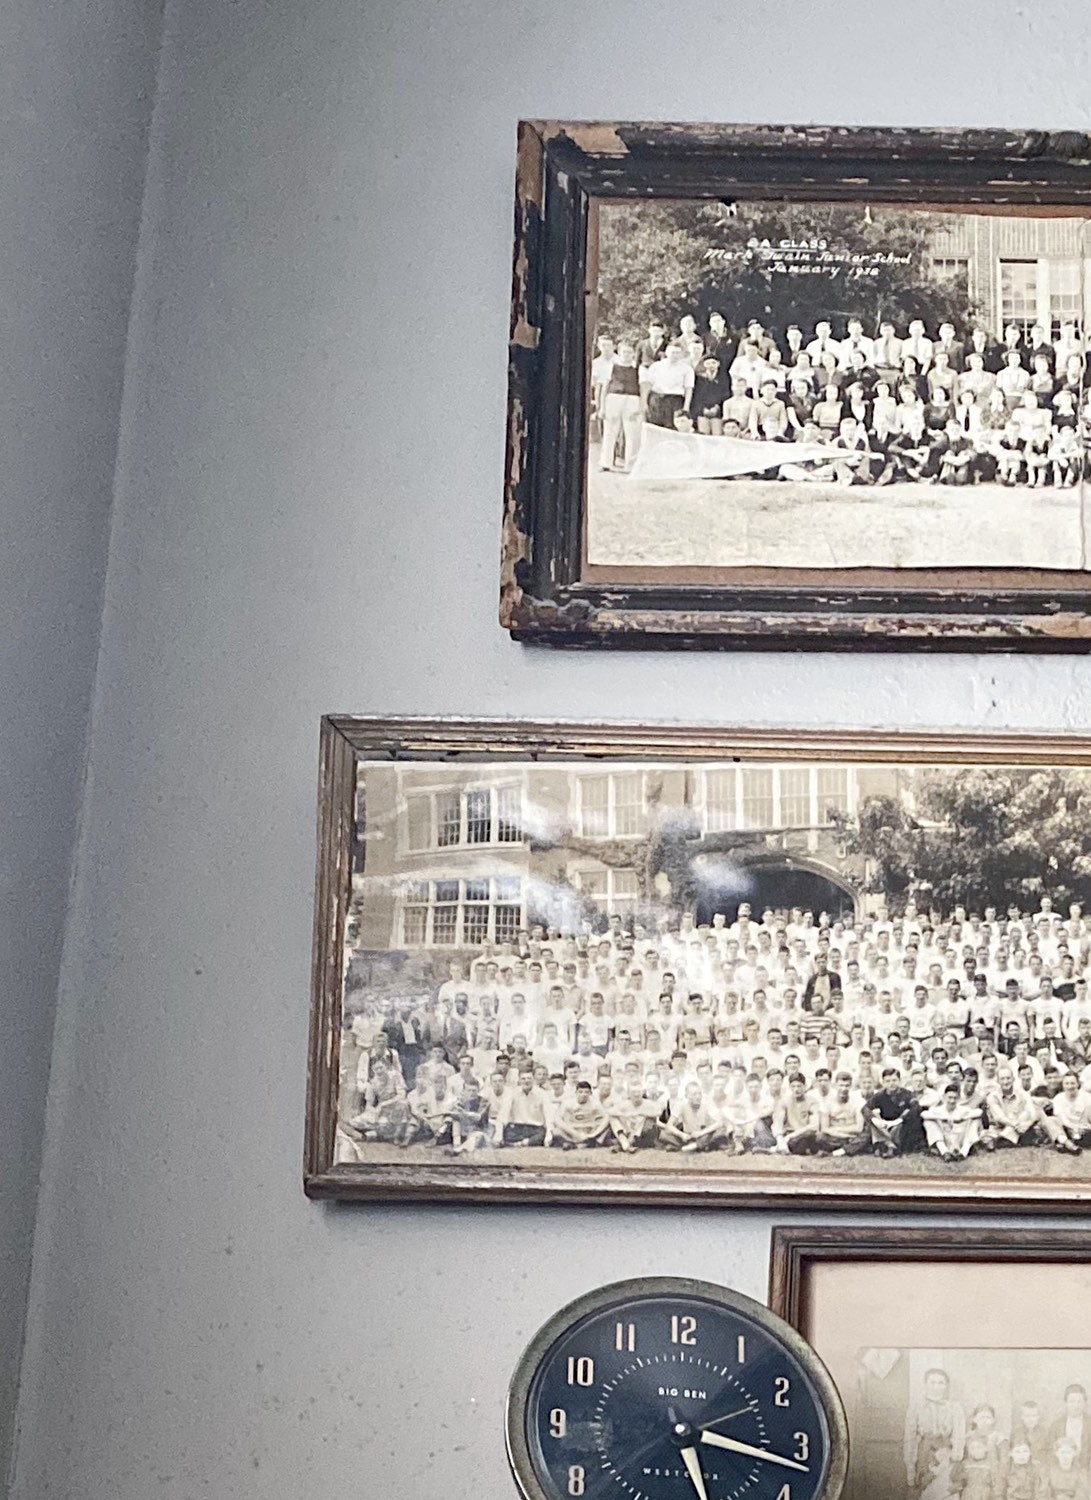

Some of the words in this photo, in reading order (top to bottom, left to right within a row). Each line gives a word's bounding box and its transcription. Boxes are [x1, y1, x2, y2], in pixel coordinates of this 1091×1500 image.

[780, 239, 827, 249] CLASS
[871, 251, 912, 265] School
[767, 261, 840, 280] January
[616, 1323, 635, 1352] 11
[671, 1315, 697, 1345] 12
[738, 1335, 745, 1363] 1
[567, 1356, 594, 1387] 10
[658, 1386, 678, 1397] BIG
[684, 1389, 706, 1400] BEN
[774, 1377, 790, 1407] 2
[549, 1408, 566, 1438] 9
[793, 1431, 809, 1461] 3
[568, 1465, 585, 1496] 8
[642, 1467, 718, 1480] WESTCOX
